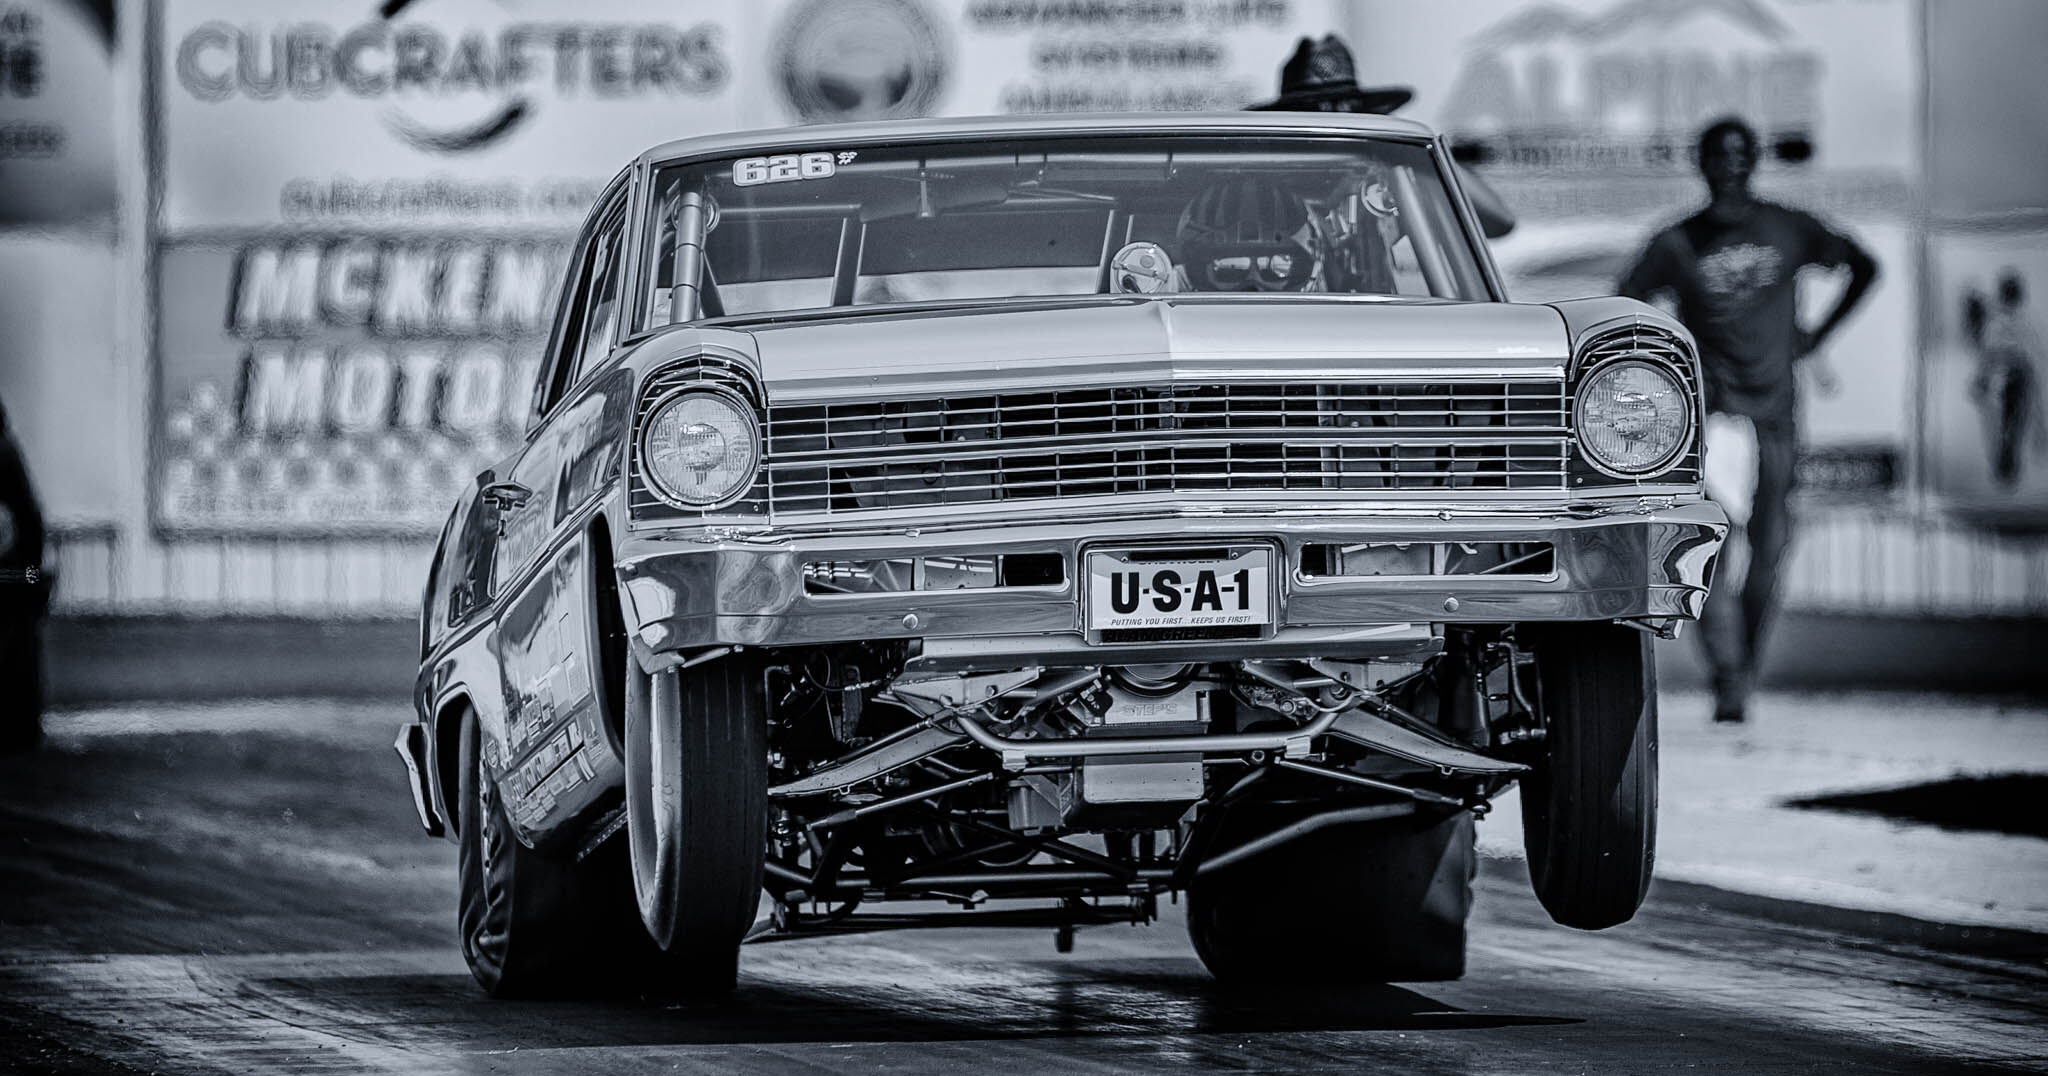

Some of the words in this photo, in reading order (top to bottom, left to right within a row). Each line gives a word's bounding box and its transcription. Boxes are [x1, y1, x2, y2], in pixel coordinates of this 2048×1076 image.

[177, 21, 732, 99] CUBCRAFTERS
[733, 152, 836, 187] 626
[1111, 617, 1142, 626] PUTTING
[1145, 617, 1160, 625] YOU
[1215, 616, 1225, 624] US
[1227, 615, 1251, 624] FIRST!
